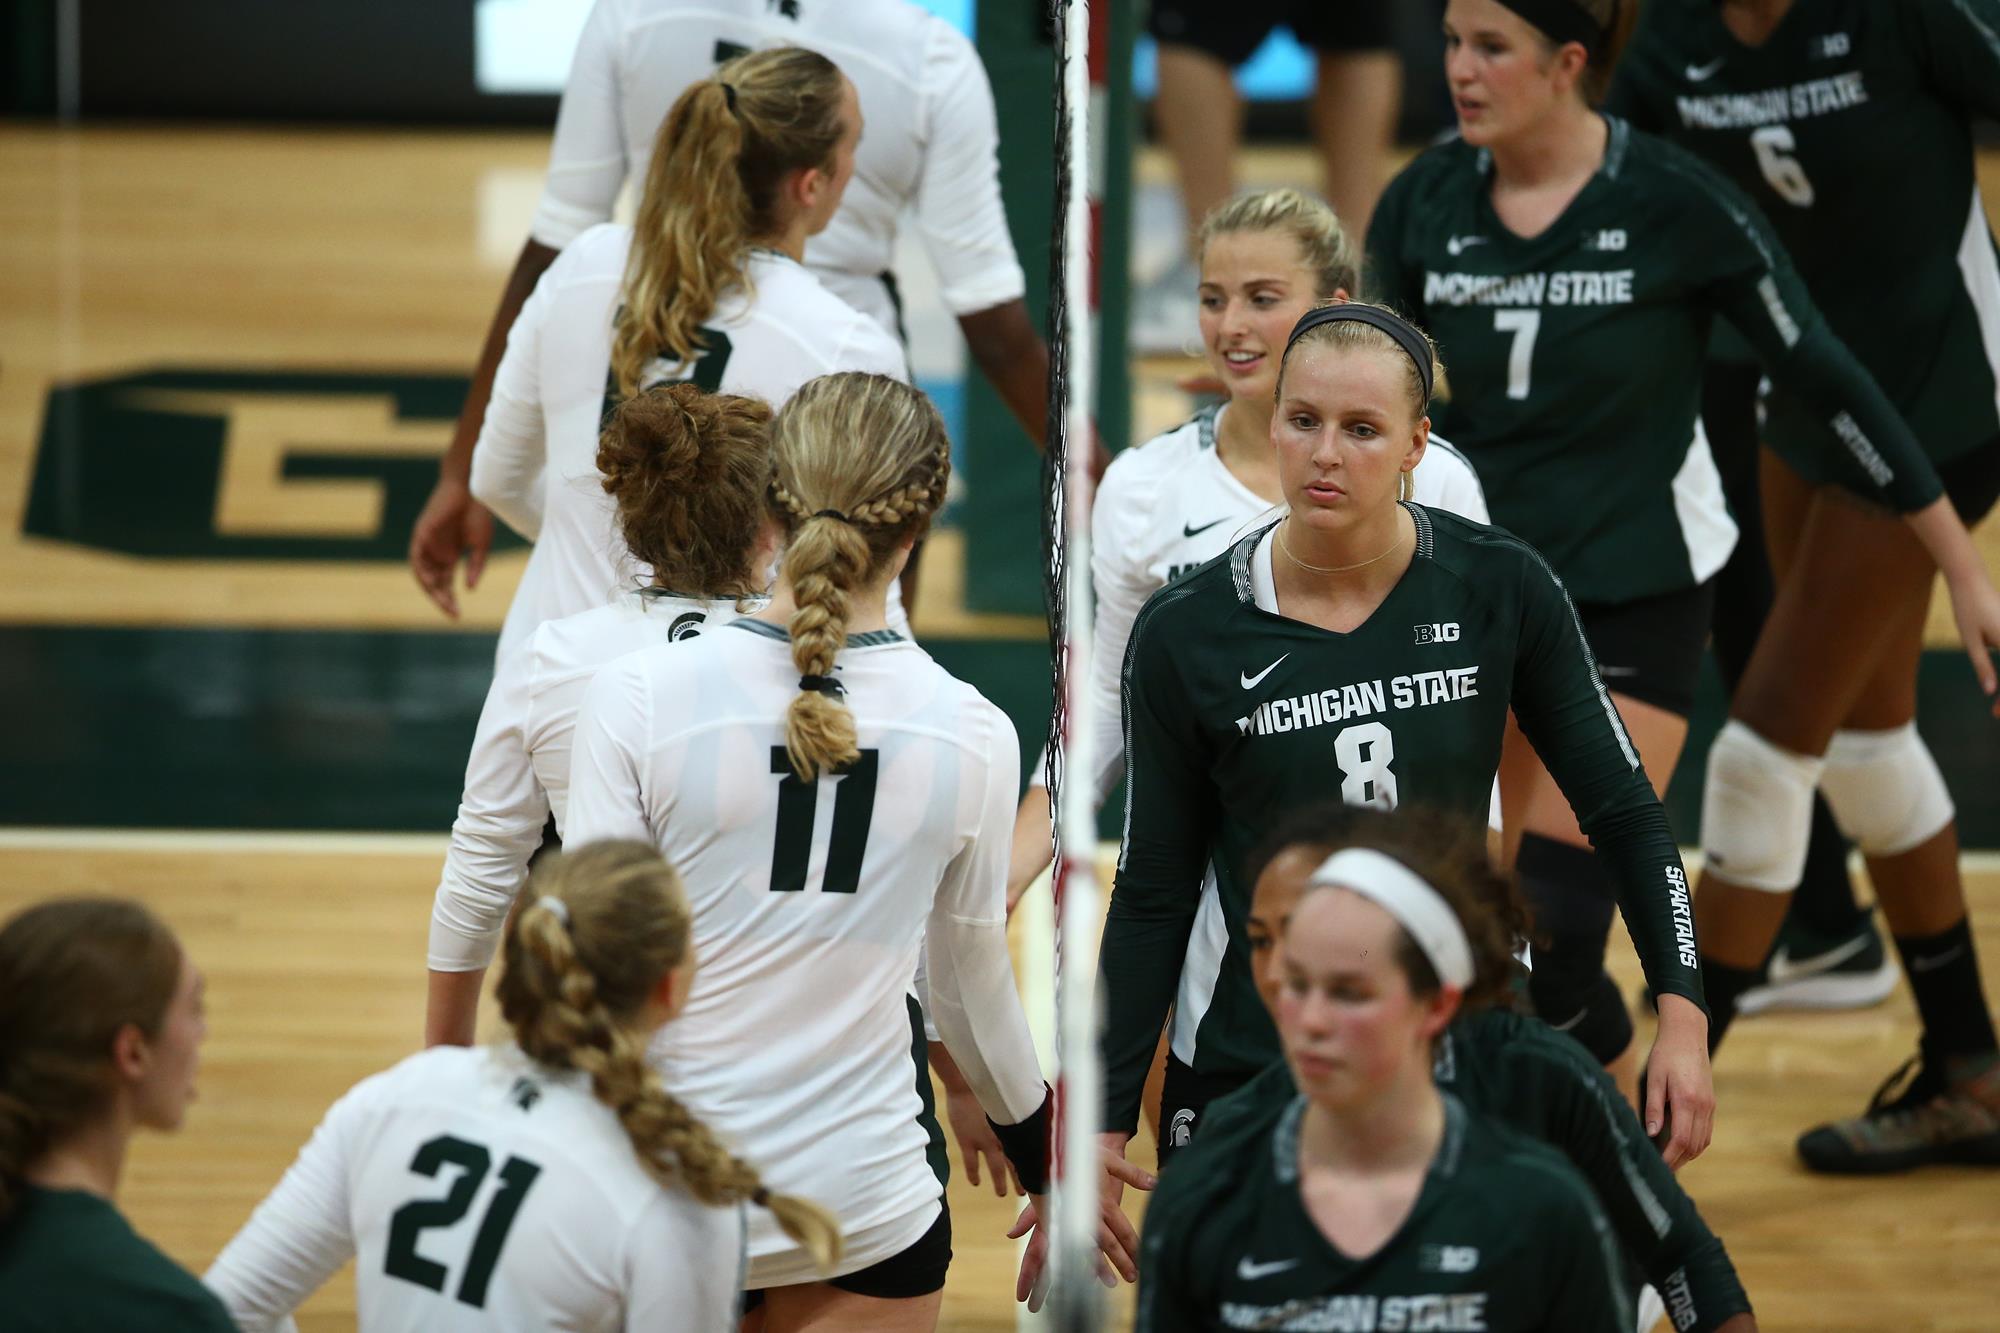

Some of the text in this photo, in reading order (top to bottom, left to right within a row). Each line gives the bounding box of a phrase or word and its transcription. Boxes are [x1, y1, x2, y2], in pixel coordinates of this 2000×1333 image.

[1751, 124, 1815, 208] 6
[1547, 269, 1635, 305] STATE
[1493, 309, 1541, 400] 7
[1235, 665, 1479, 736] MICHIGAN STATE
[1333, 721, 1399, 812] 8
[770, 745, 880, 894] 11
[1665, 865, 1698, 970] SPARTANS
[383, 1133, 542, 1309] 21
